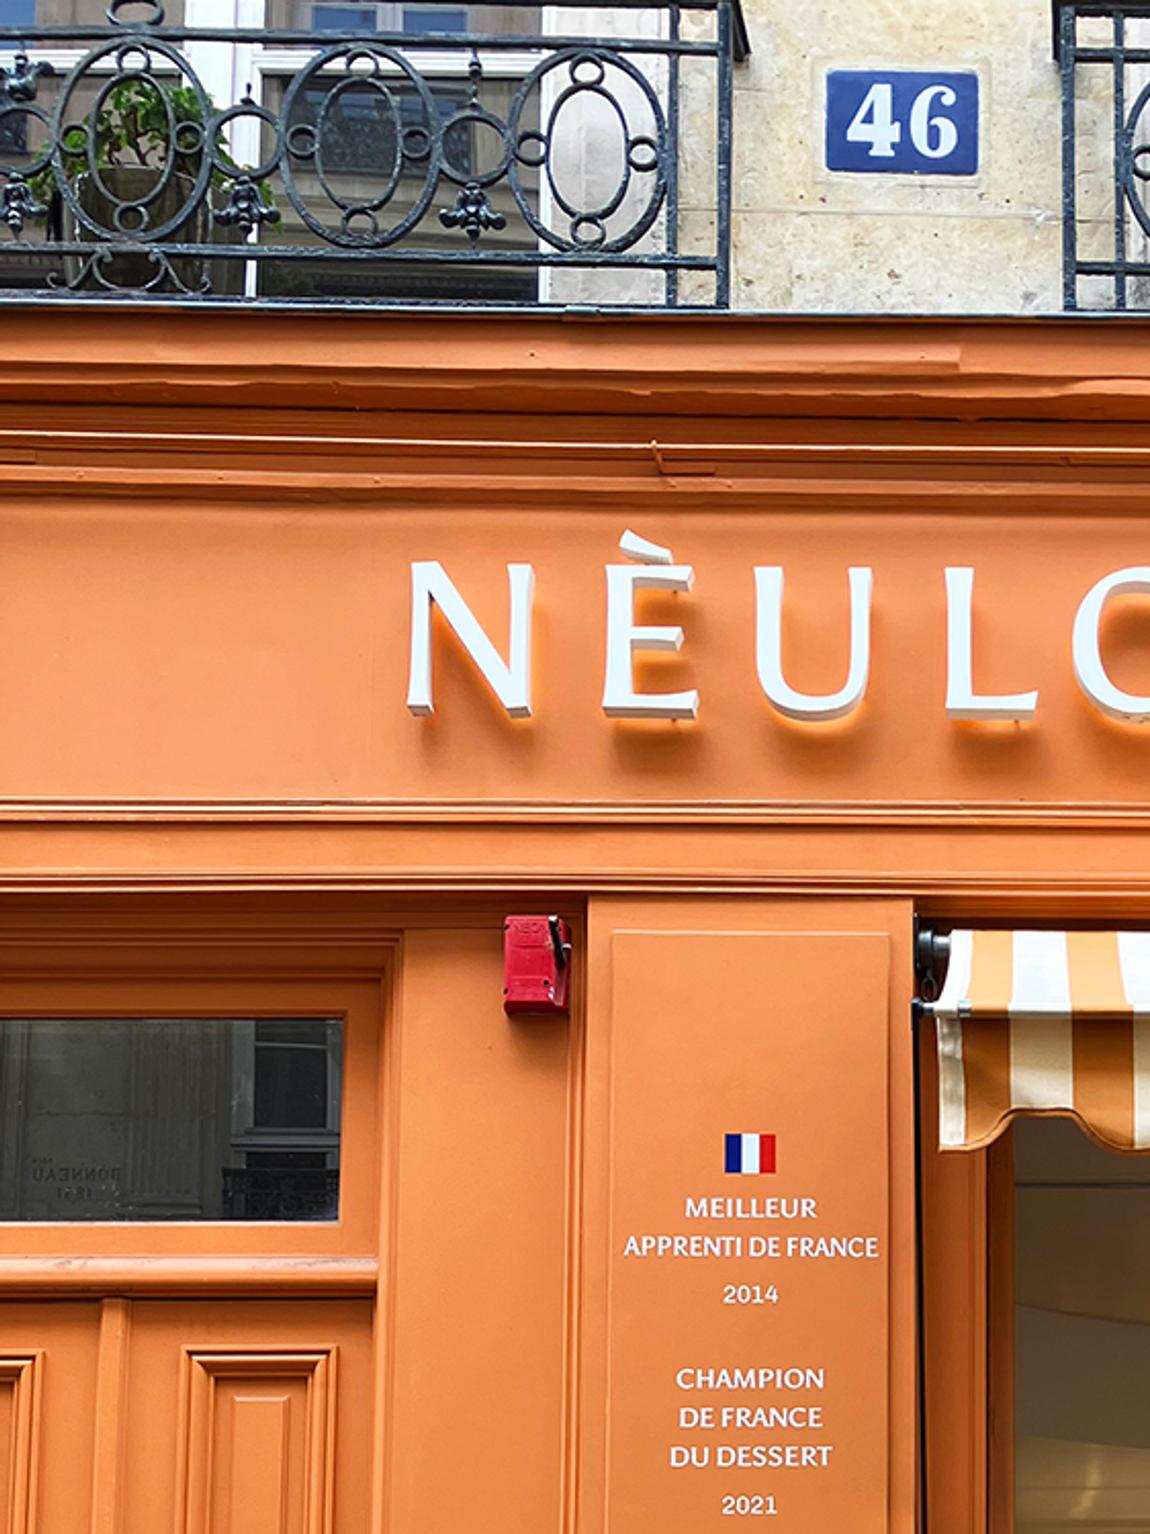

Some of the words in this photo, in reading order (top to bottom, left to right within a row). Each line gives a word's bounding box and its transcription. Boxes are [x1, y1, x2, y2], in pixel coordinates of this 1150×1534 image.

[846, 83, 958, 159] 46
[684, 1196, 817, 1219] MEILLEUR
[623, 1235, 743, 1258] APPRENTI
[748, 1235, 781, 1258] DE
[786, 1235, 880, 1259] FRANCE
[723, 1284, 779, 1305] 2014
[675, 1367, 825, 1390] CHAMPION
[679, 1407, 714, 1429] DE
[720, 1407, 824, 1429] FRANCE
[670, 1446, 710, 1468] DU
[716, 1445, 833, 1468] DESSERT
[721, 1495, 778, 1516] 2021
